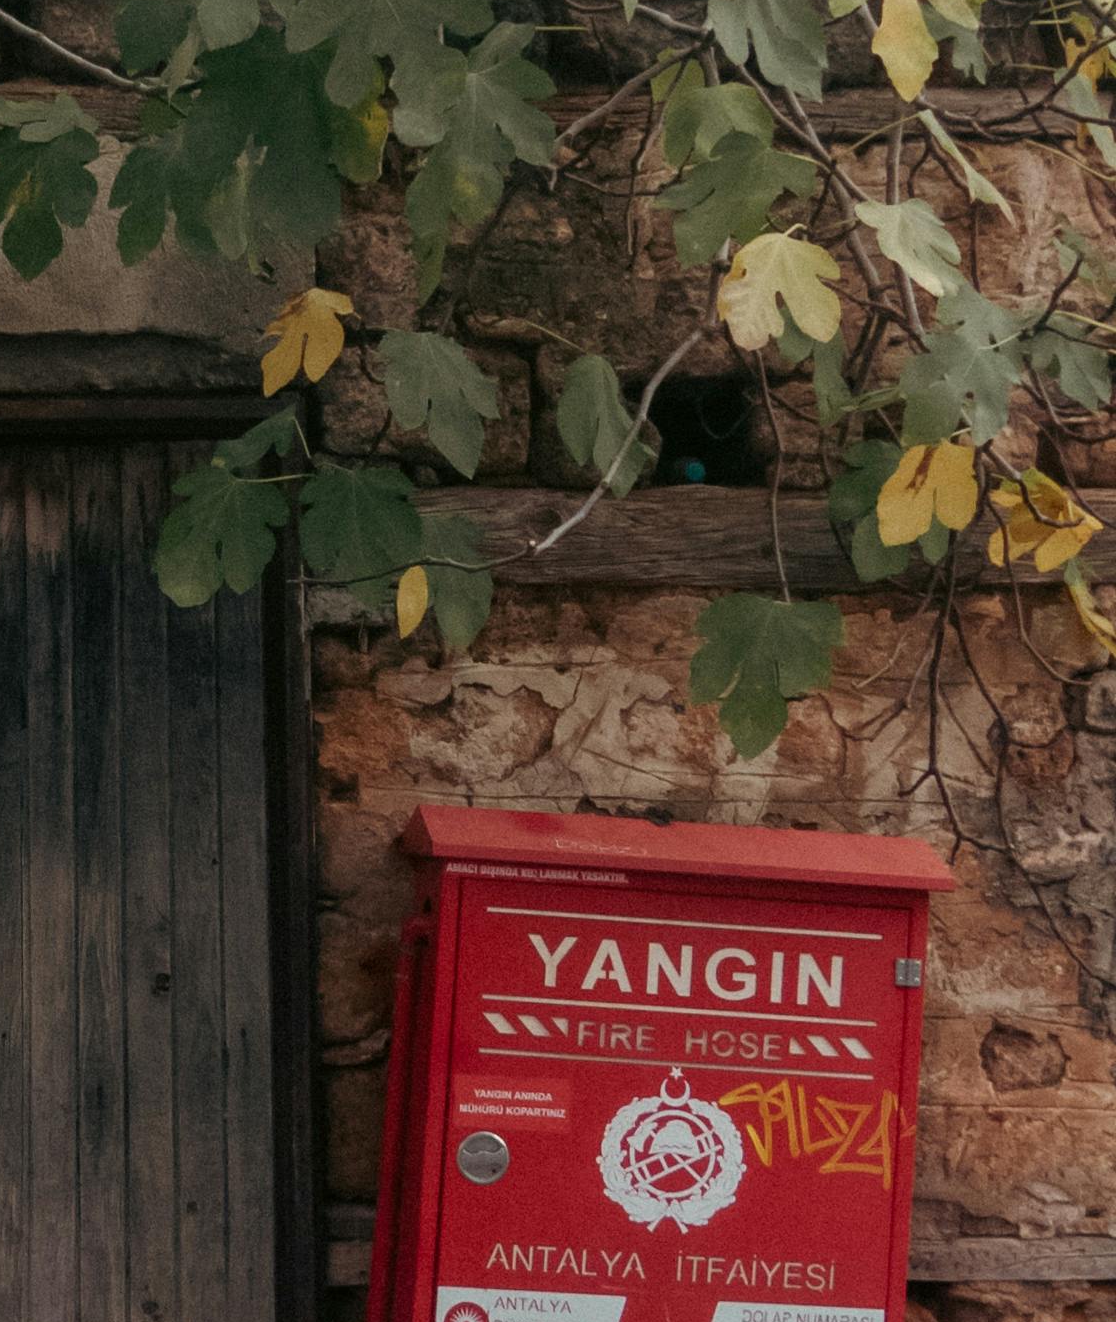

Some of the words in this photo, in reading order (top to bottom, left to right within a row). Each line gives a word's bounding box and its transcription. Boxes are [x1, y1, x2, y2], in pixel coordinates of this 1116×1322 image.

[528, 933, 843, 1008] YANGIN
[577, 1020, 656, 1052] FIRE
[685, 1029, 782, 1061] HOSE
[474, 1089, 512, 1100] YANGIN
[514, 1091, 553, 1101] ANINDA
[506, 1106, 566, 1118] KOPARTINIZ
[486, 1242, 646, 1279] ANTALYA
[494, 1296, 572, 1314] ANTALYA
